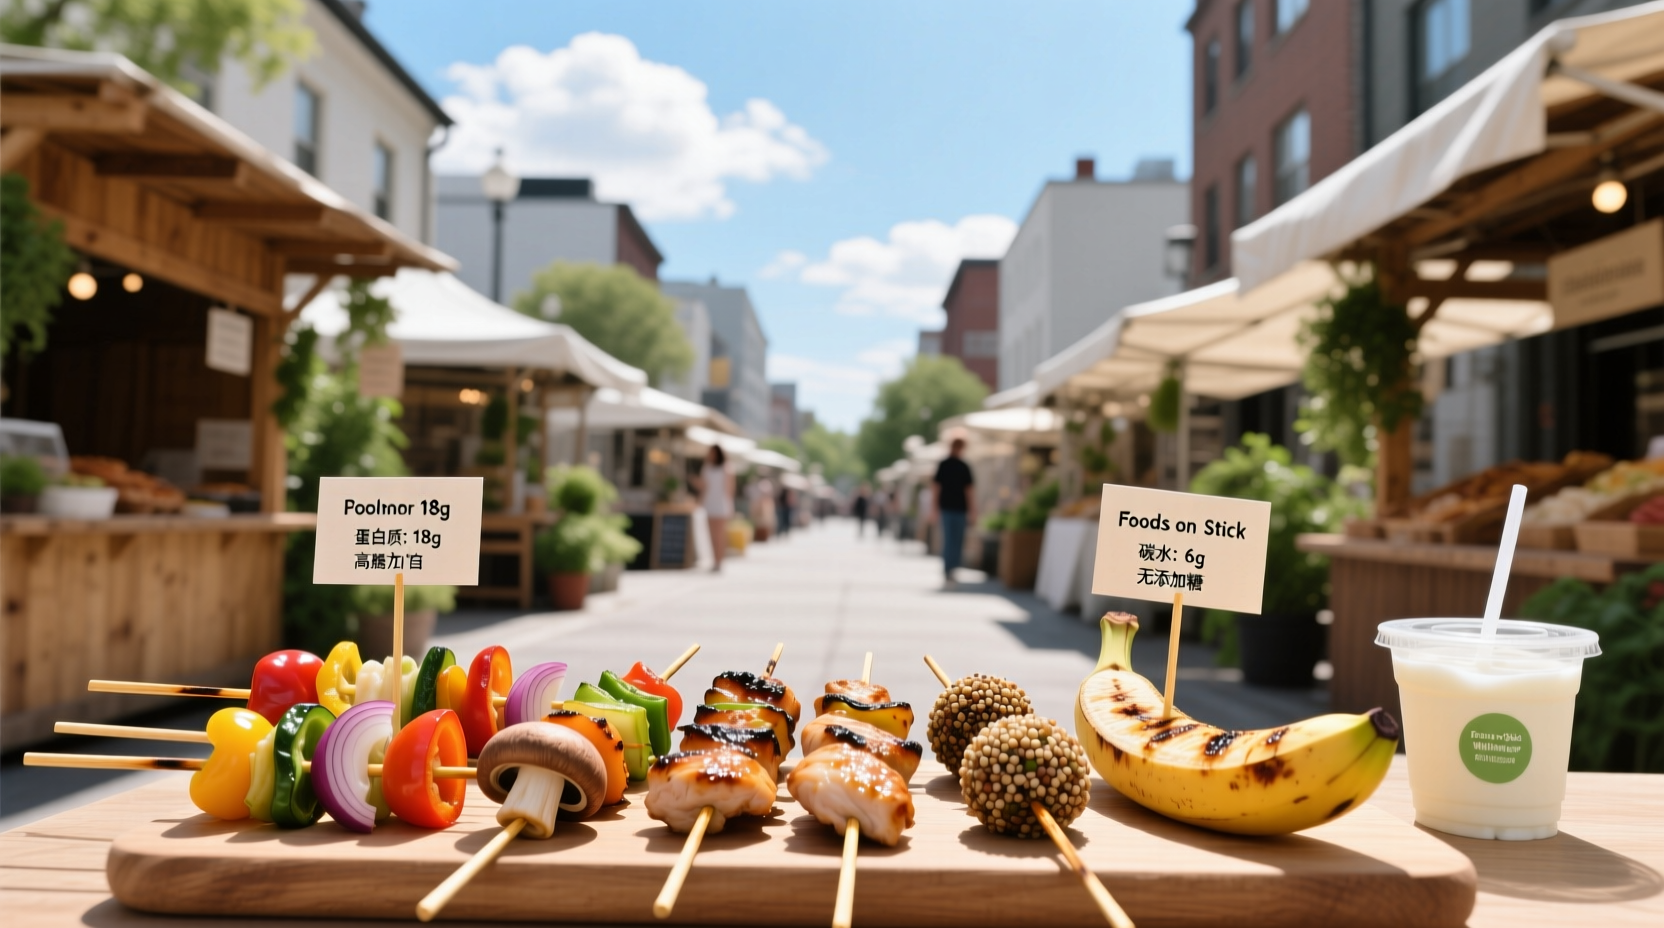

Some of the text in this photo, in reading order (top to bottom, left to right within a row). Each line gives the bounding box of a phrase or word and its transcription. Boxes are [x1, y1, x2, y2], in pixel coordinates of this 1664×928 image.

[420, 498, 451, 522] 18g
[1118, 510, 1248, 540] Foods on Stick
[412, 529, 442, 549] 18g
[1184, 548, 1206, 570] 6g
[1136, 567, 1206, 592] 无添加糖
